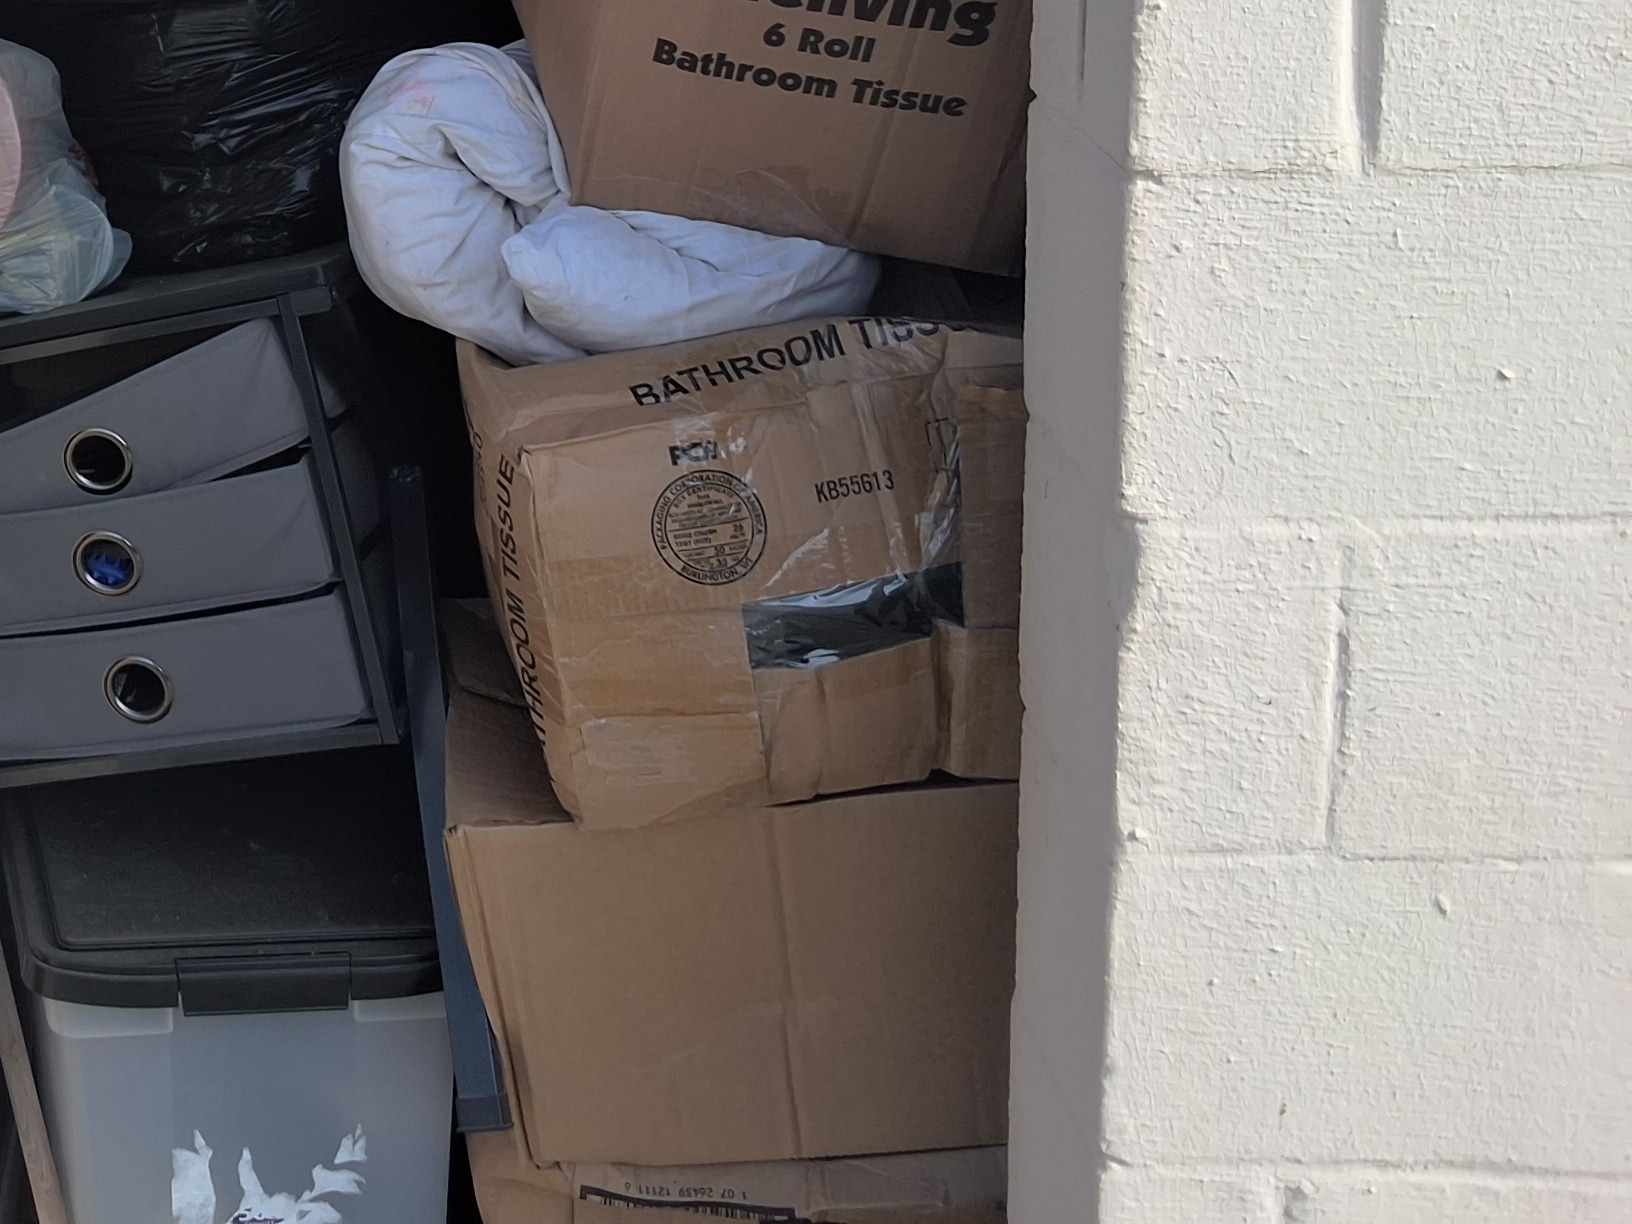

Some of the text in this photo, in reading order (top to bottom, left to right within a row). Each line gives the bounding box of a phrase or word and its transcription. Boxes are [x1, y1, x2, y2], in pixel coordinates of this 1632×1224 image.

[652, 38, 968, 117] Bathroom Tissue
[763, 23, 876, 63] 6 Roll
[629, 324, 846, 407] BATHROOM
[669, 473, 733, 497] CORPORATION
[744, 494, 764, 535] AMERICA
[813, 470, 895, 504] KB55613
[496, 454, 546, 750] THROOM TISSUE
